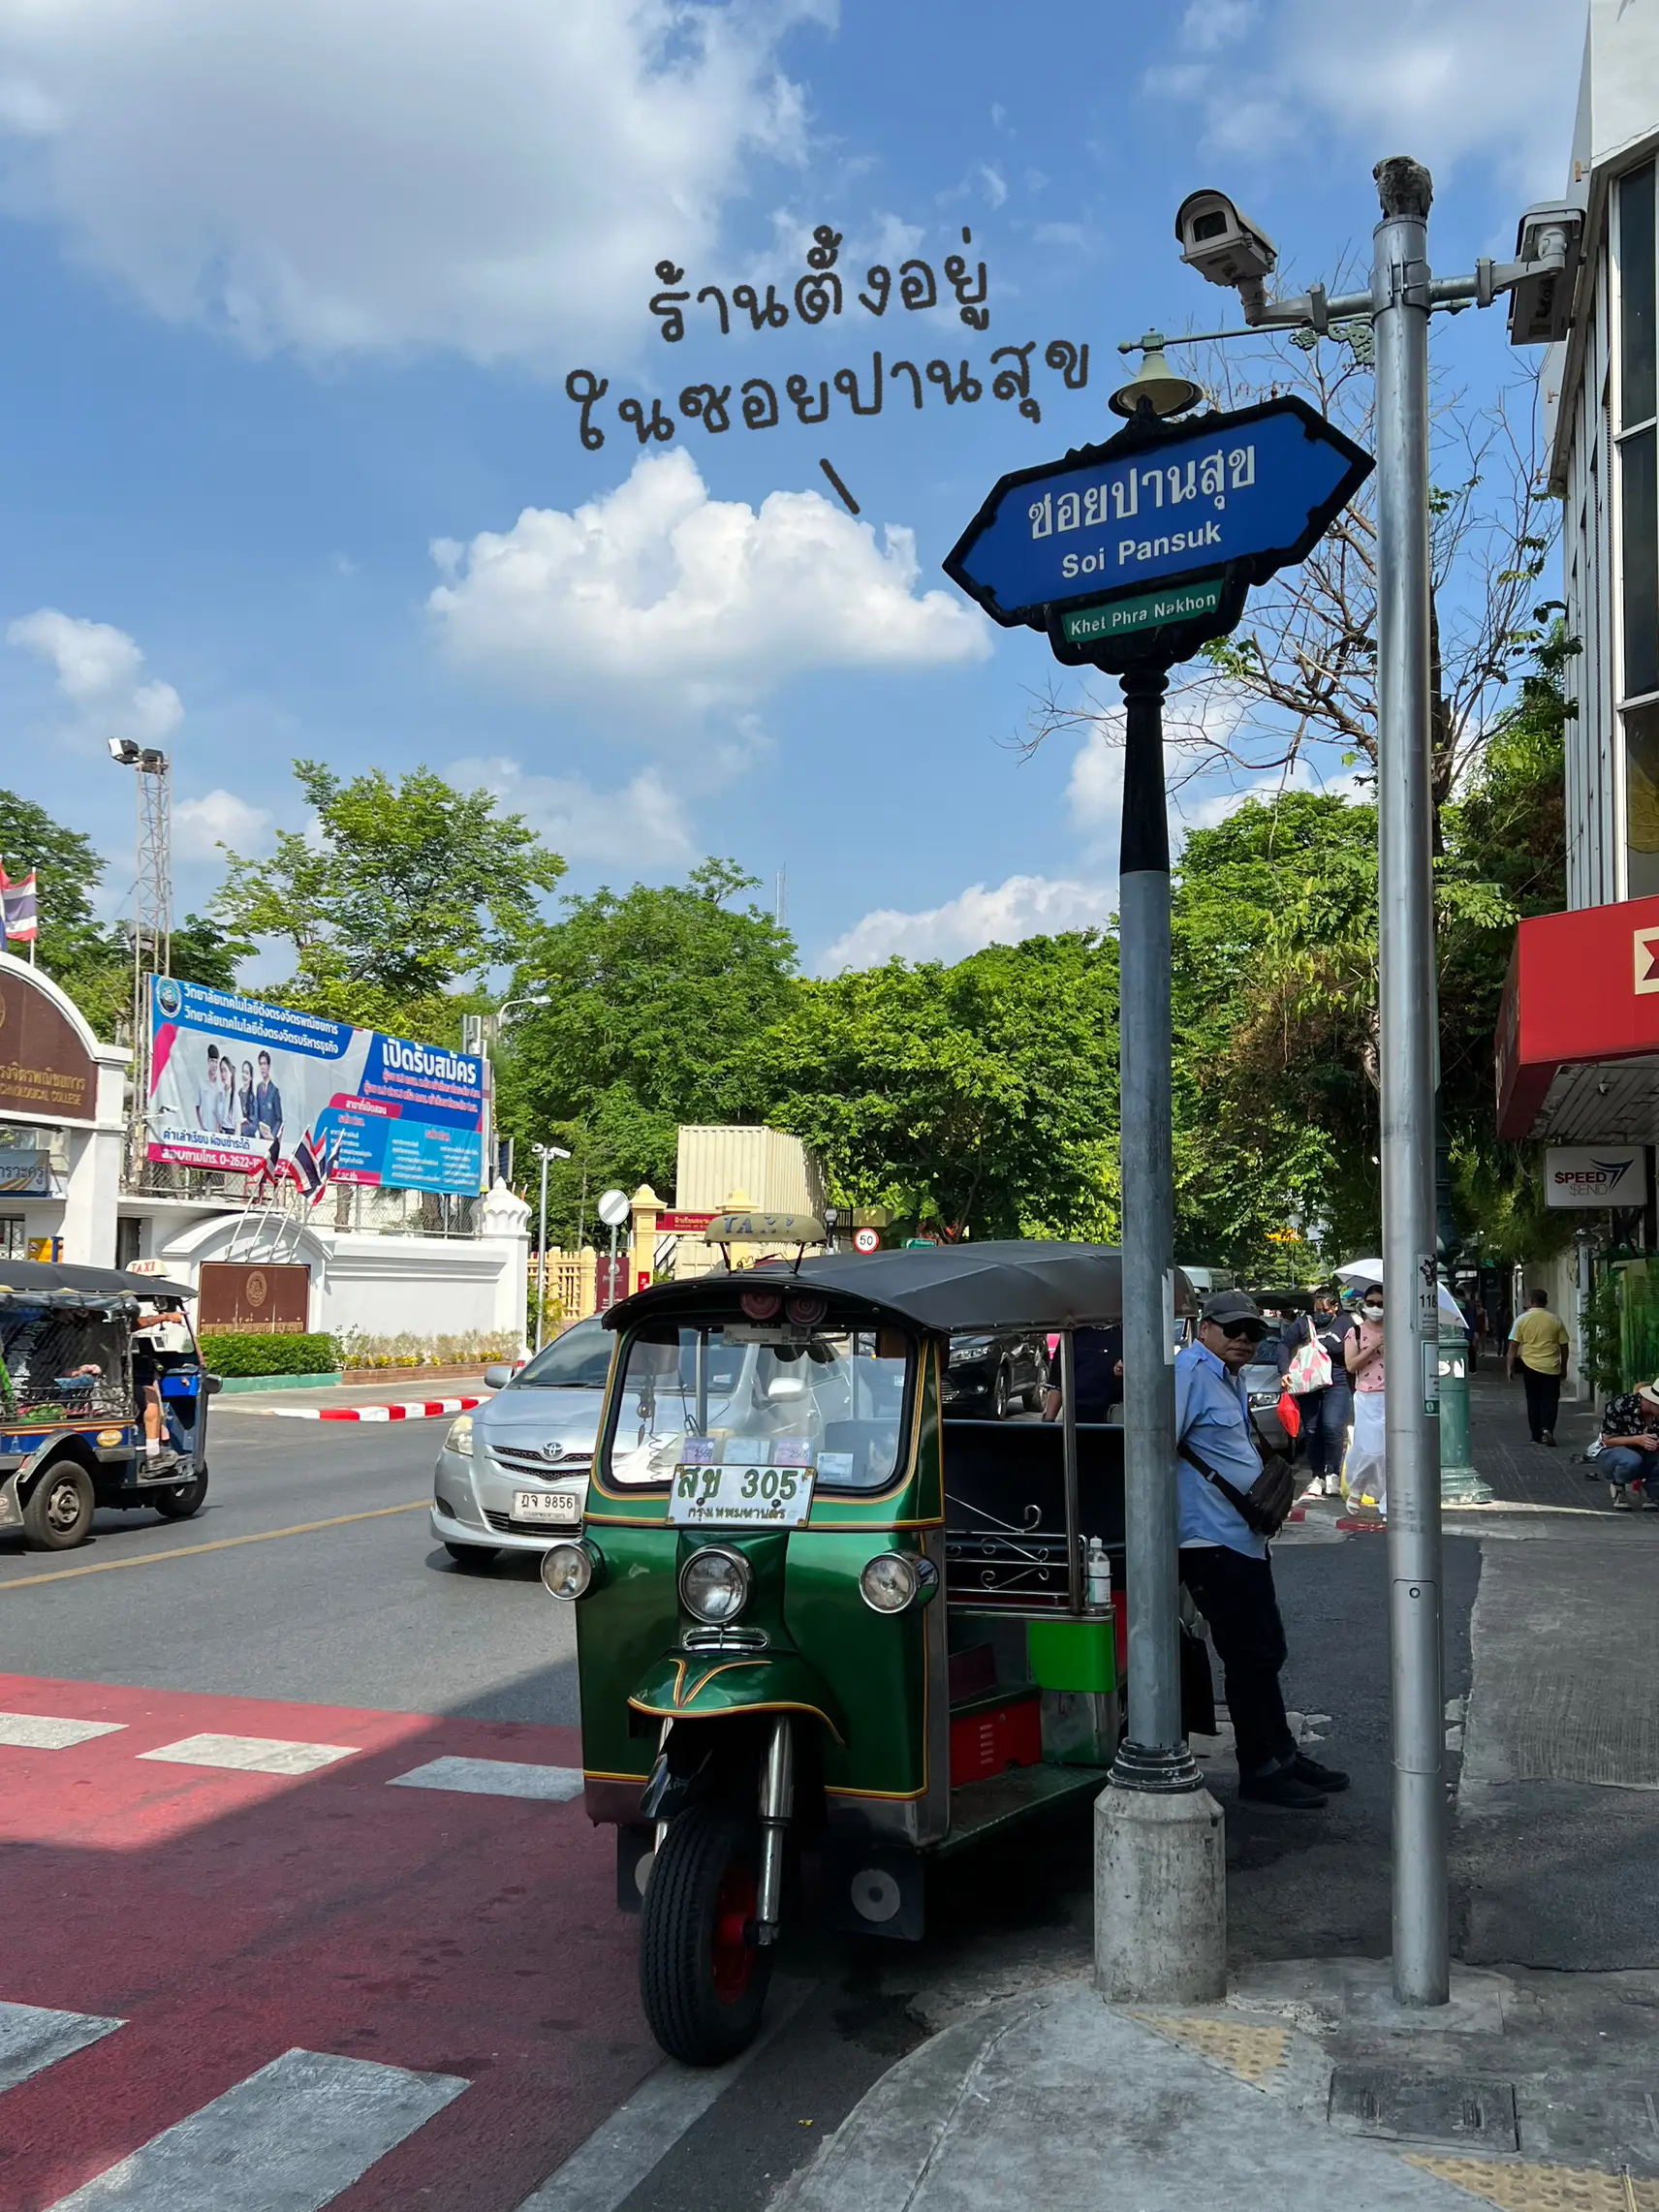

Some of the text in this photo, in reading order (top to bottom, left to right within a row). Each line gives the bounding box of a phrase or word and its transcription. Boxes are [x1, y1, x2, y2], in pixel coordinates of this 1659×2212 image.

[1027, 444, 1256, 541] ซอยปานสุข
[1062, 520, 1222, 578] Soi Pansuk
[1071, 594, 1216, 636] Khet Phra Nakhon
[383, 1038, 477, 1084] เปิดรับสมัคร
[860, 1234, 873, 1246] 50
[131, 1261, 155, 1273] TAXI
[545, 1495, 574, 1509] 9856
[740, 1468, 798, 1500] 305
